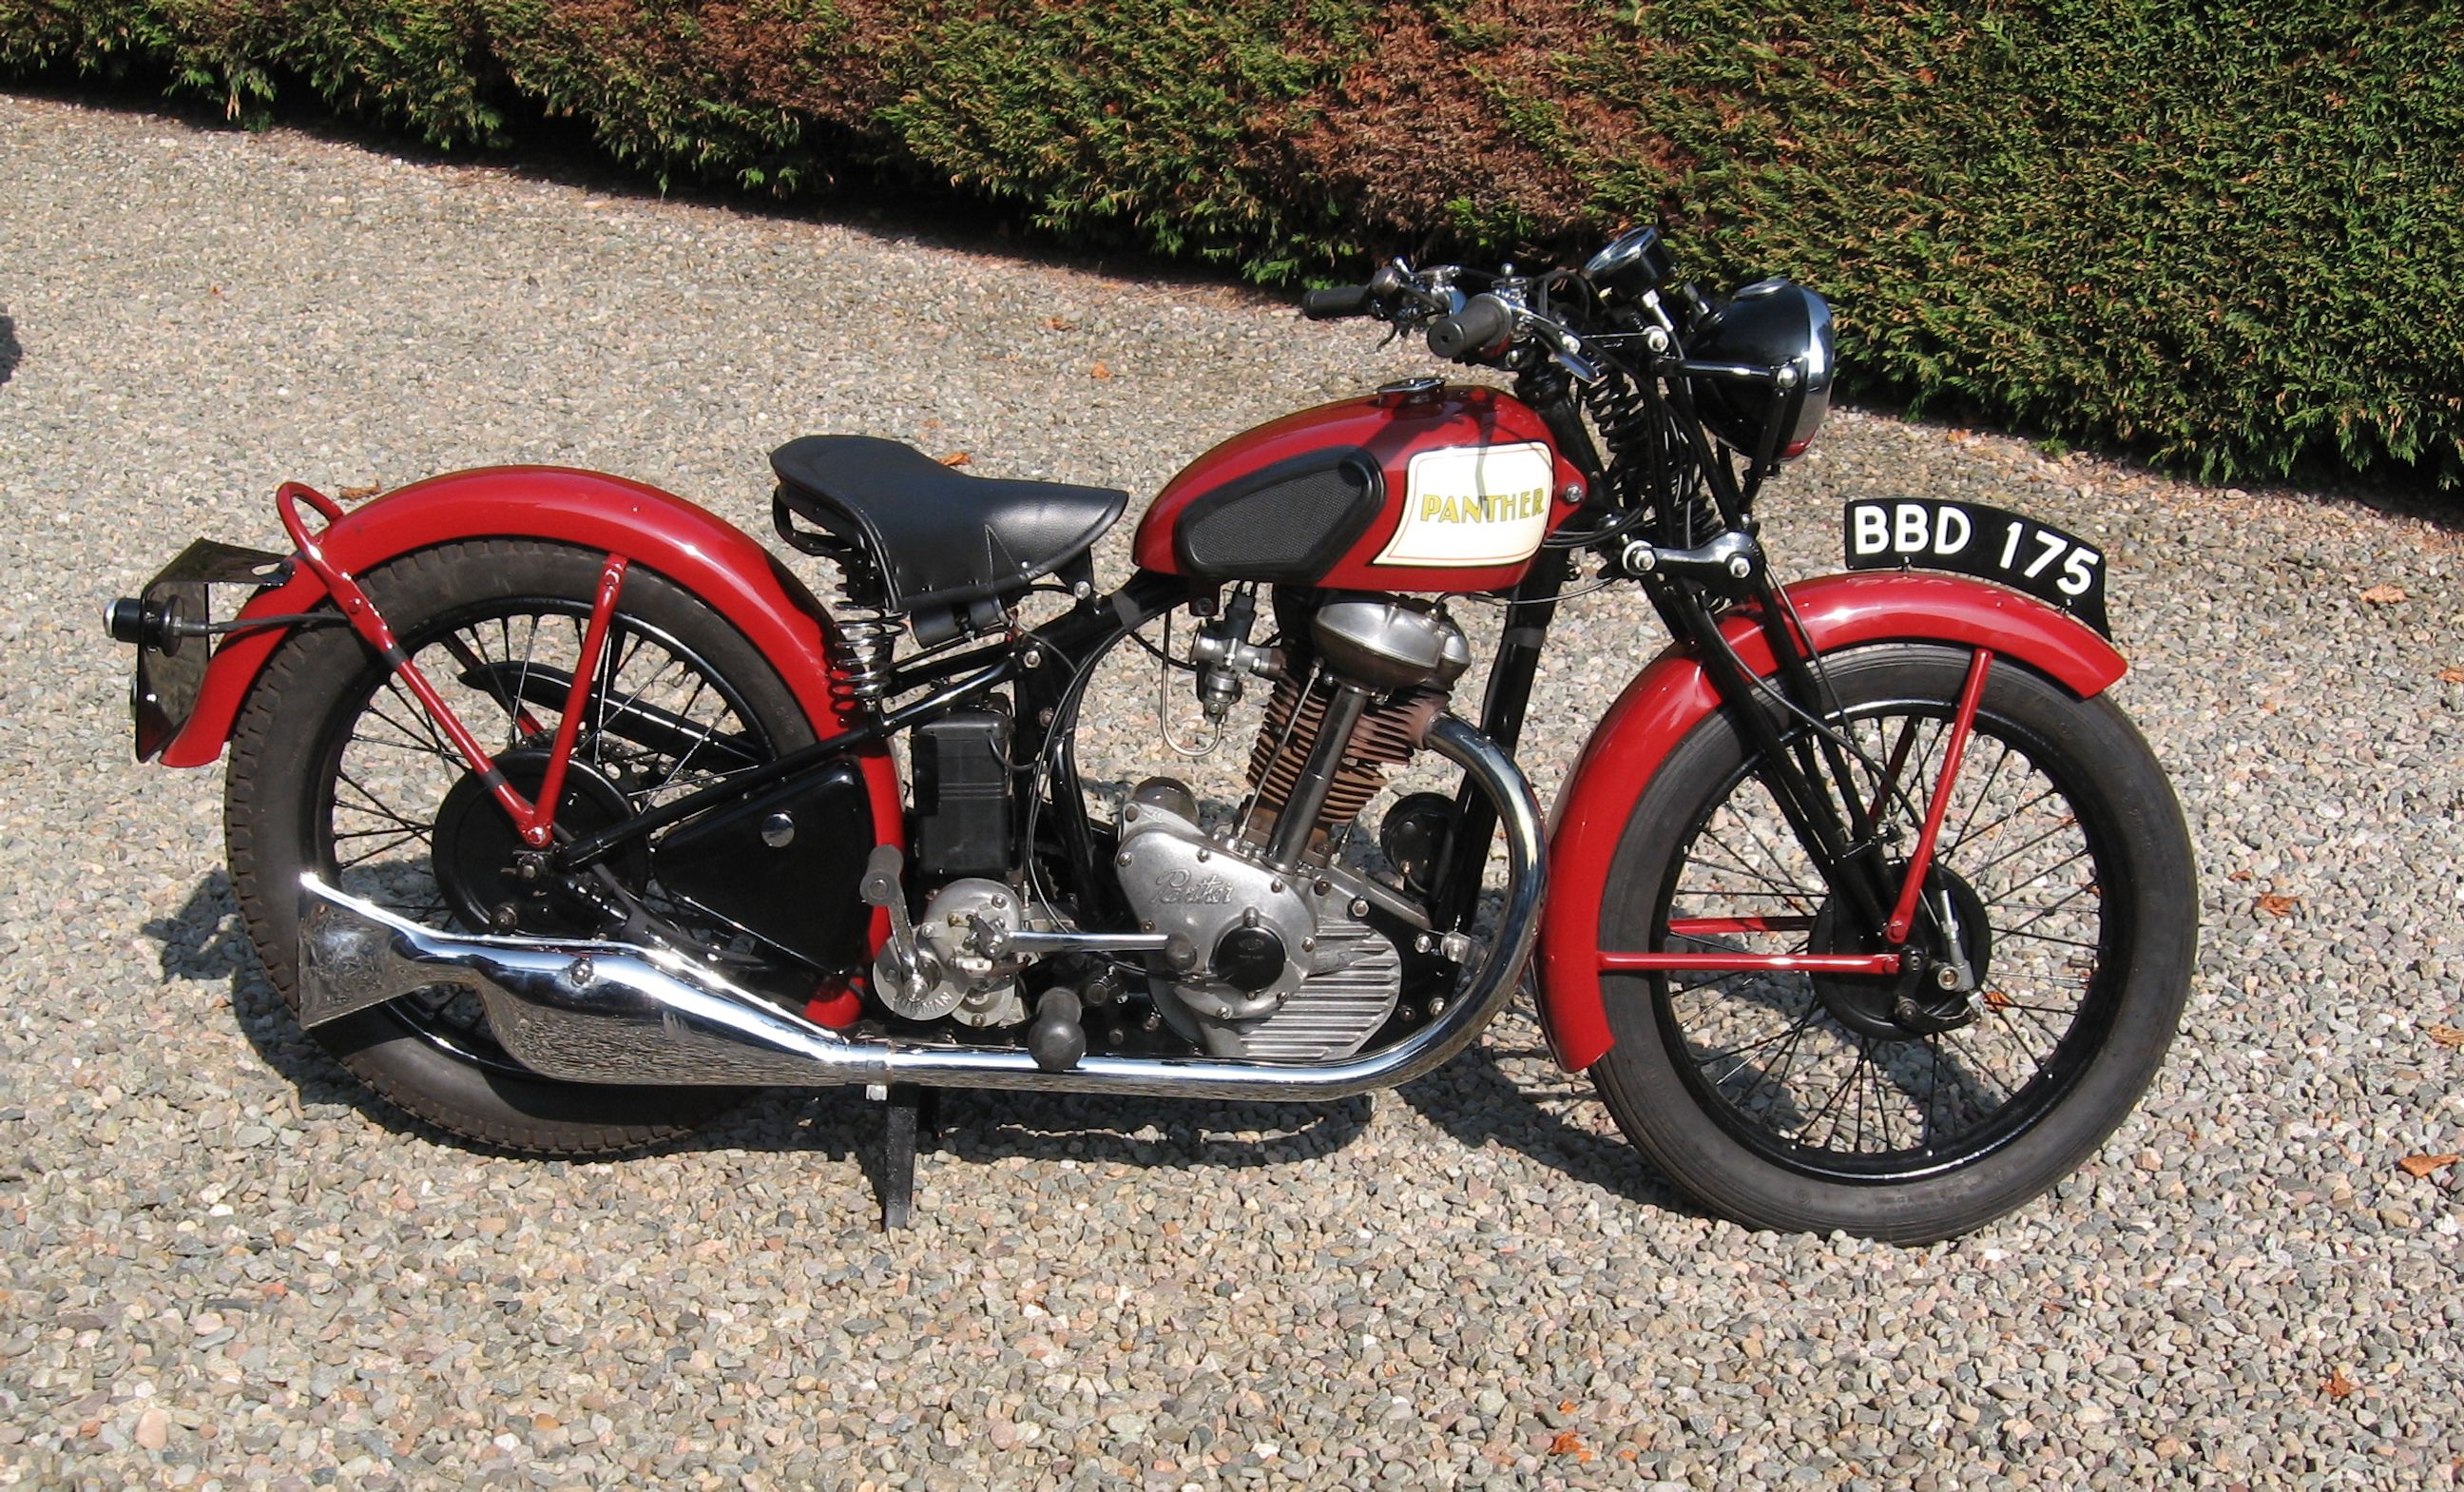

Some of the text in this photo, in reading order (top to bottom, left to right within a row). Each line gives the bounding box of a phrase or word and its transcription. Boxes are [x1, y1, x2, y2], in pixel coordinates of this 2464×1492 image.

[1420, 487, 1545, 523] PANTHER
[1855, 504, 2100, 595] BBD 175
